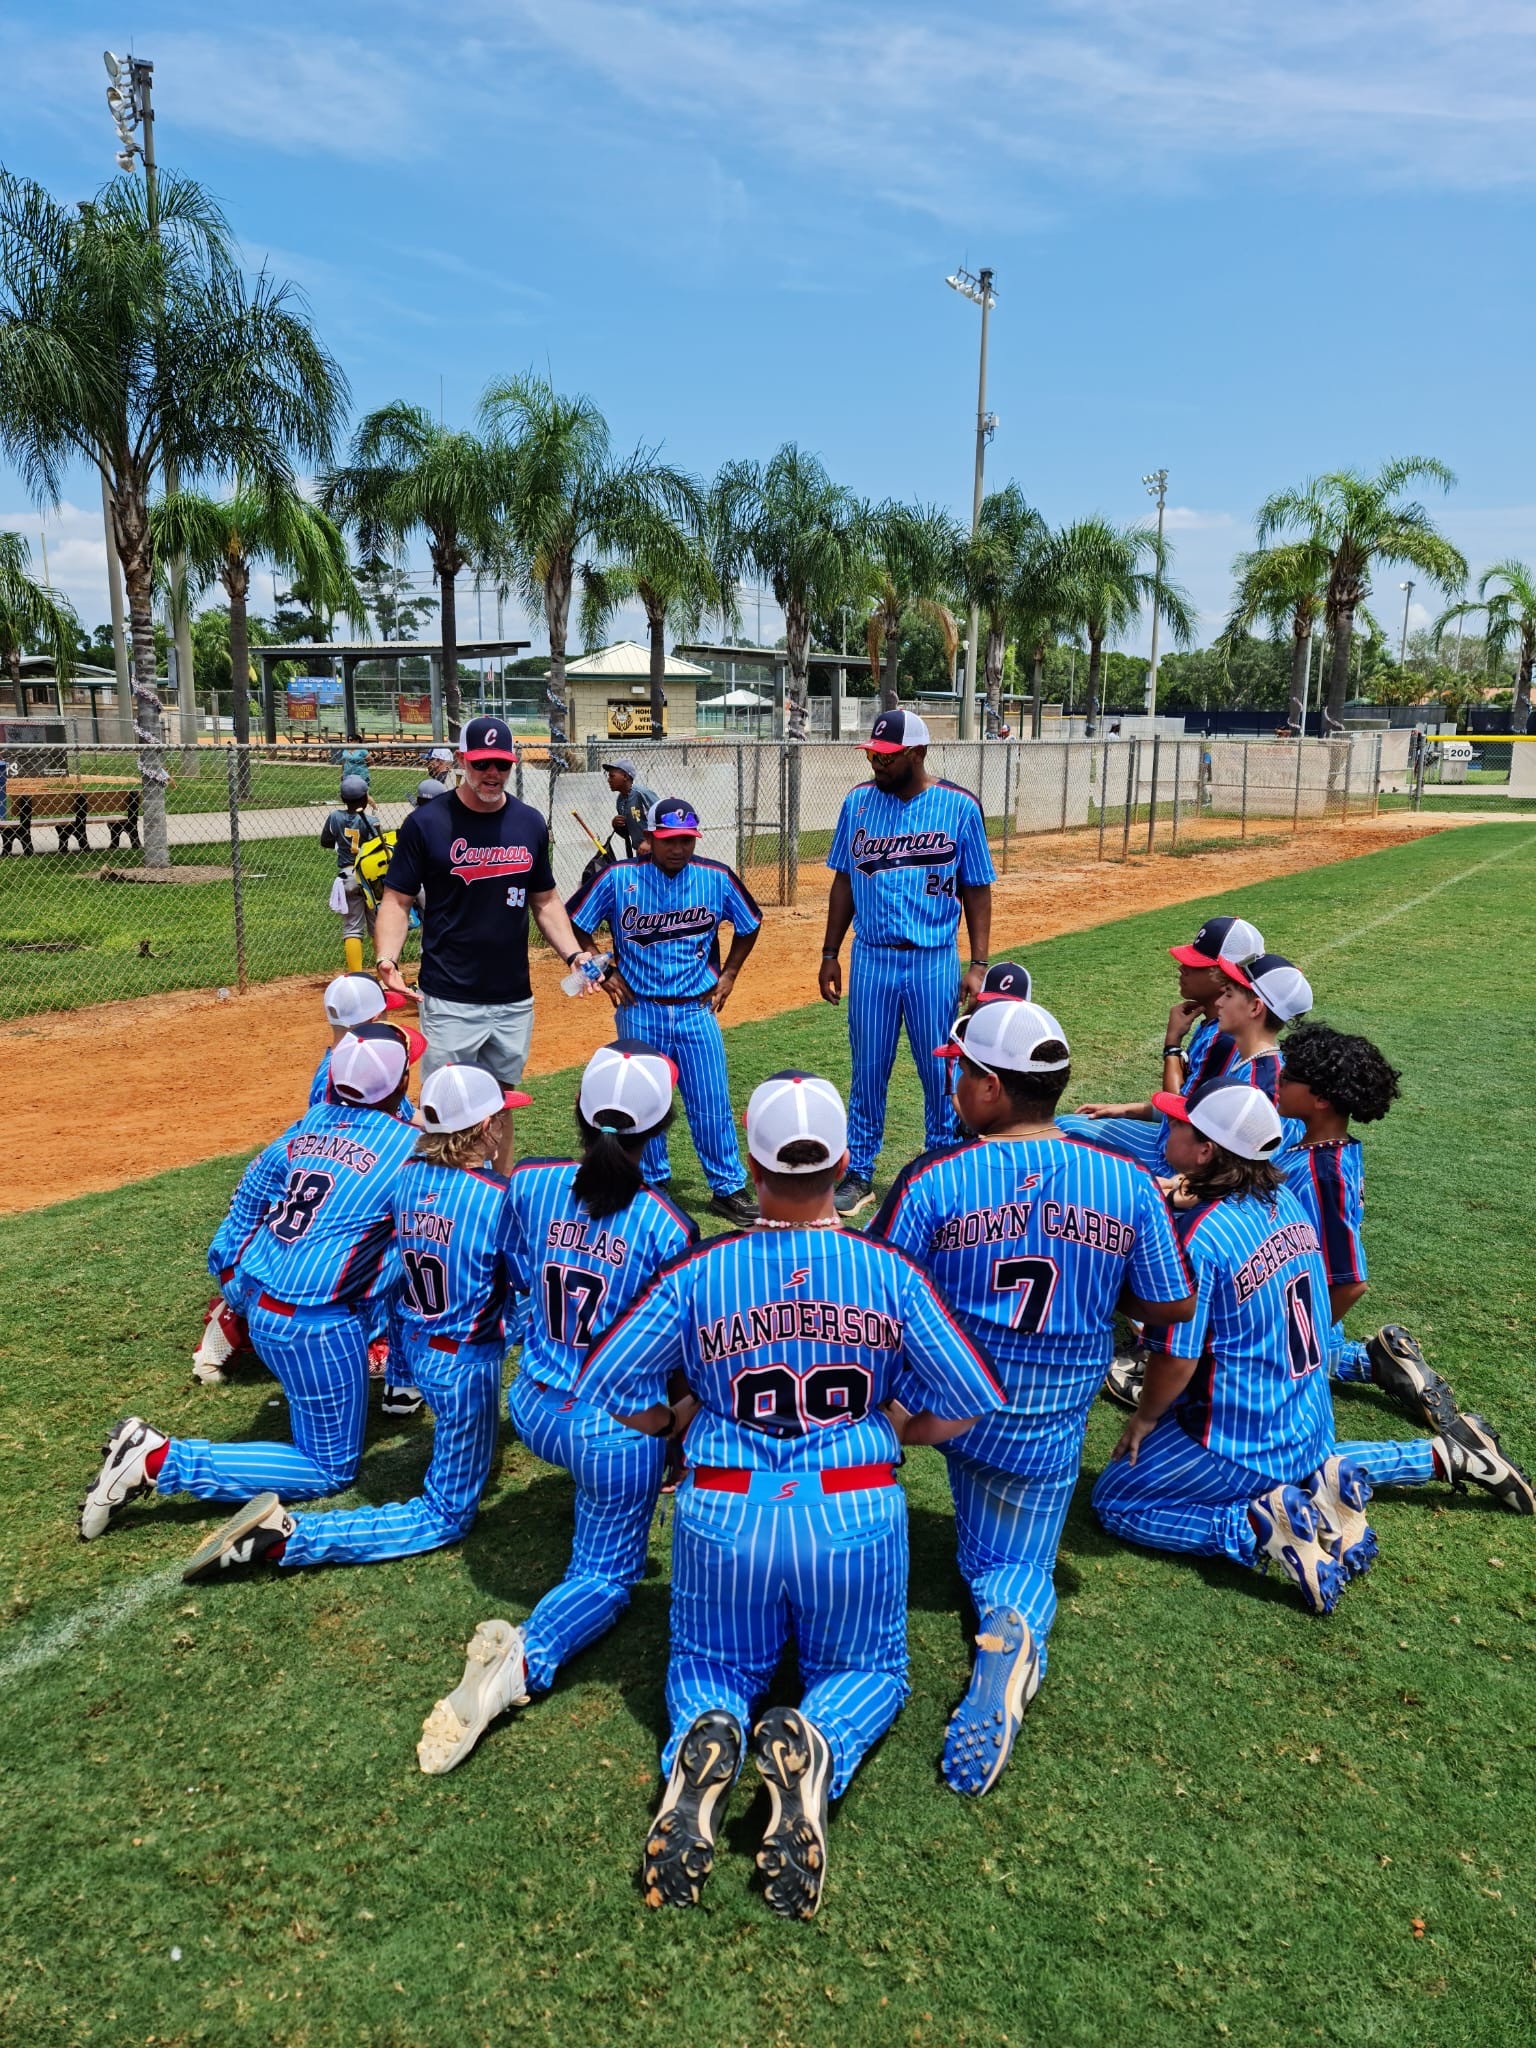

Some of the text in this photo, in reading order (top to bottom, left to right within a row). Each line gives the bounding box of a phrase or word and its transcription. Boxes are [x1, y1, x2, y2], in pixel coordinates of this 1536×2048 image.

[484, 728, 498, 746] C
[874, 720, 887, 736] C
[1450, 749, 1471, 758] 200
[344, 827, 360, 855] 7
[450, 837, 530, 867] Cayman
[850, 827, 953, 860] Cayman
[506, 886, 526, 908] 33
[925, 873, 954, 898] 24
[620, 904, 710, 940] Cayman
[999, 974, 1014, 991] C
[291, 1133, 379, 1176] EBANKS
[265, 1168, 336, 1244] 18
[400, 1211, 454, 1246] LYON
[547, 1219, 627, 1268] SOLAS
[1042, 1200, 1136, 1258] CARBO
[402, 1249, 449, 1320] 10
[991, 1255, 1059, 1335] 7
[543, 1262, 608, 1348] 17
[699, 1301, 904, 1363] MANDERSON
[1284, 1271, 1322, 1379] 11
[731, 1363, 874, 1440] 99
